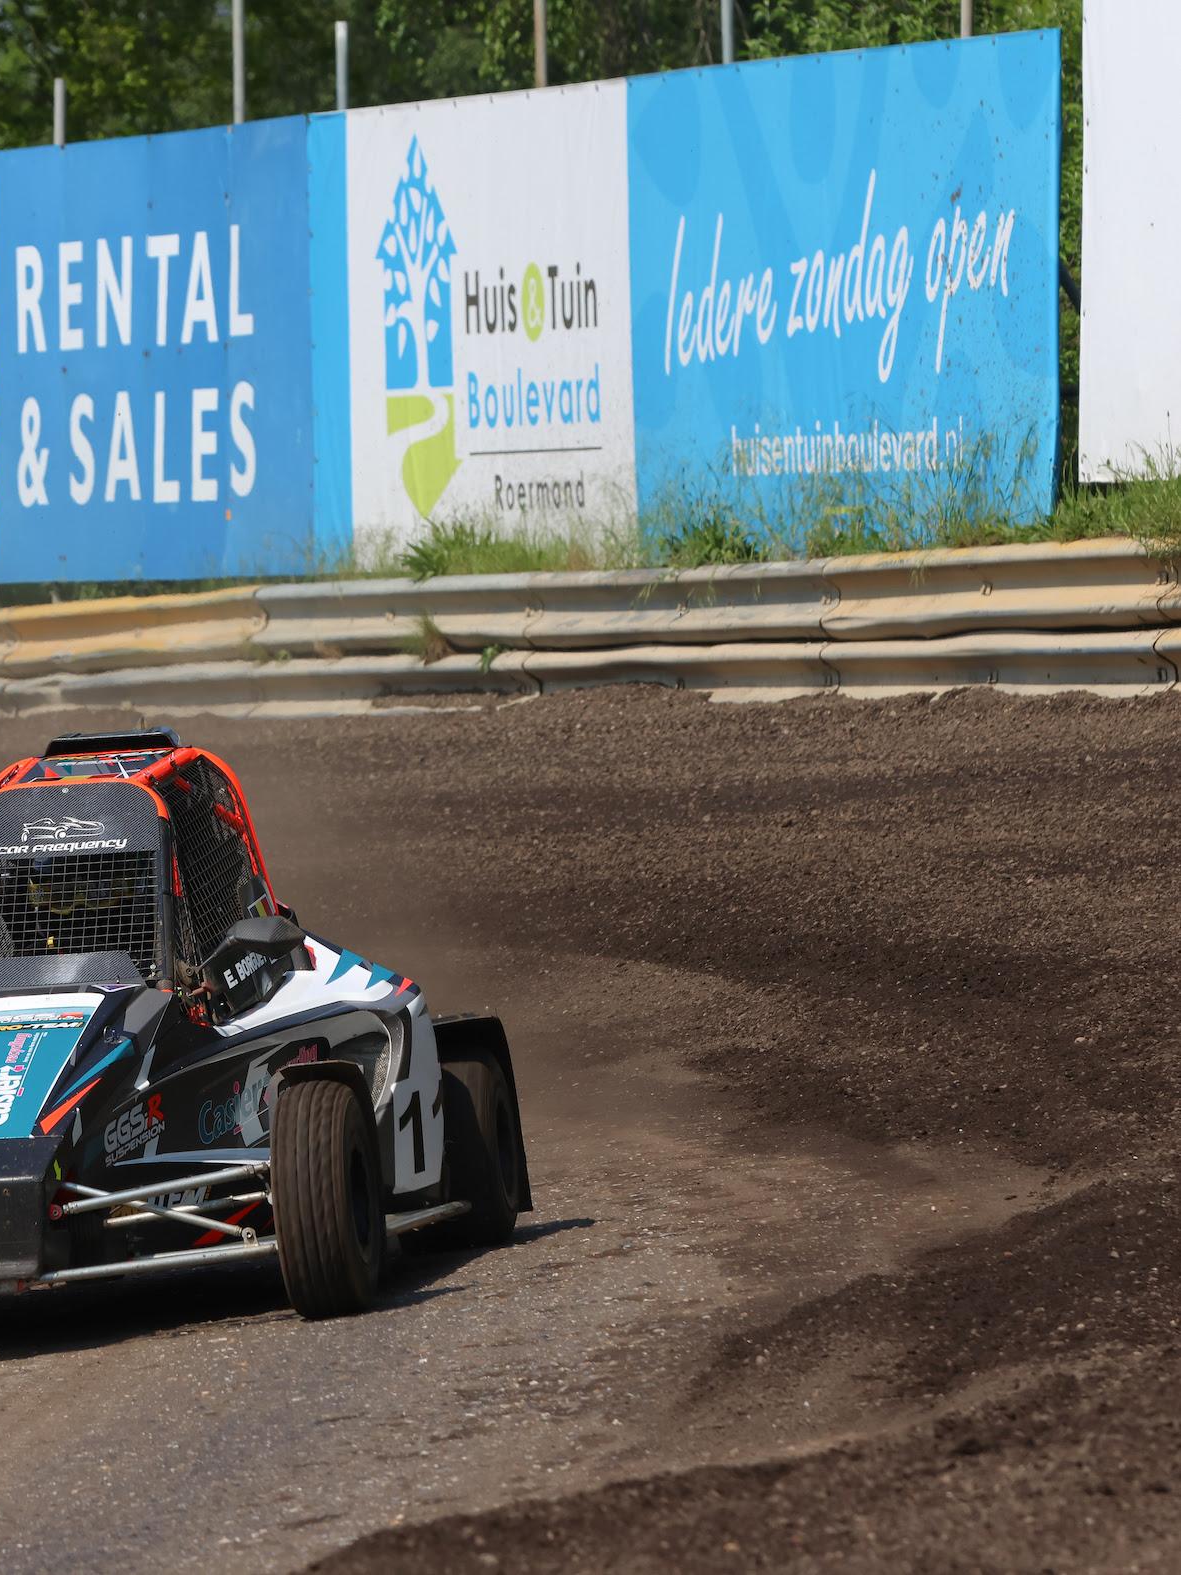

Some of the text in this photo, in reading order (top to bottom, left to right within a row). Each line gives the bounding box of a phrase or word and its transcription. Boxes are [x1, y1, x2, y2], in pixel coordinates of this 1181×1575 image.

[15, 224, 254, 353] RENTAL
[464, 267, 517, 334] Huis
[547, 262, 598, 330] Tuin
[665, 168, 1016, 383] Iedere zondag open
[467, 363, 601, 429] Boulevard
[17, 380, 257, 508] & SALES
[731, 416, 963, 476] huisentuinboulevard.nl
[494, 471, 585, 510] Roermond
[105, 1120, 165, 1168] SUSPENSION
